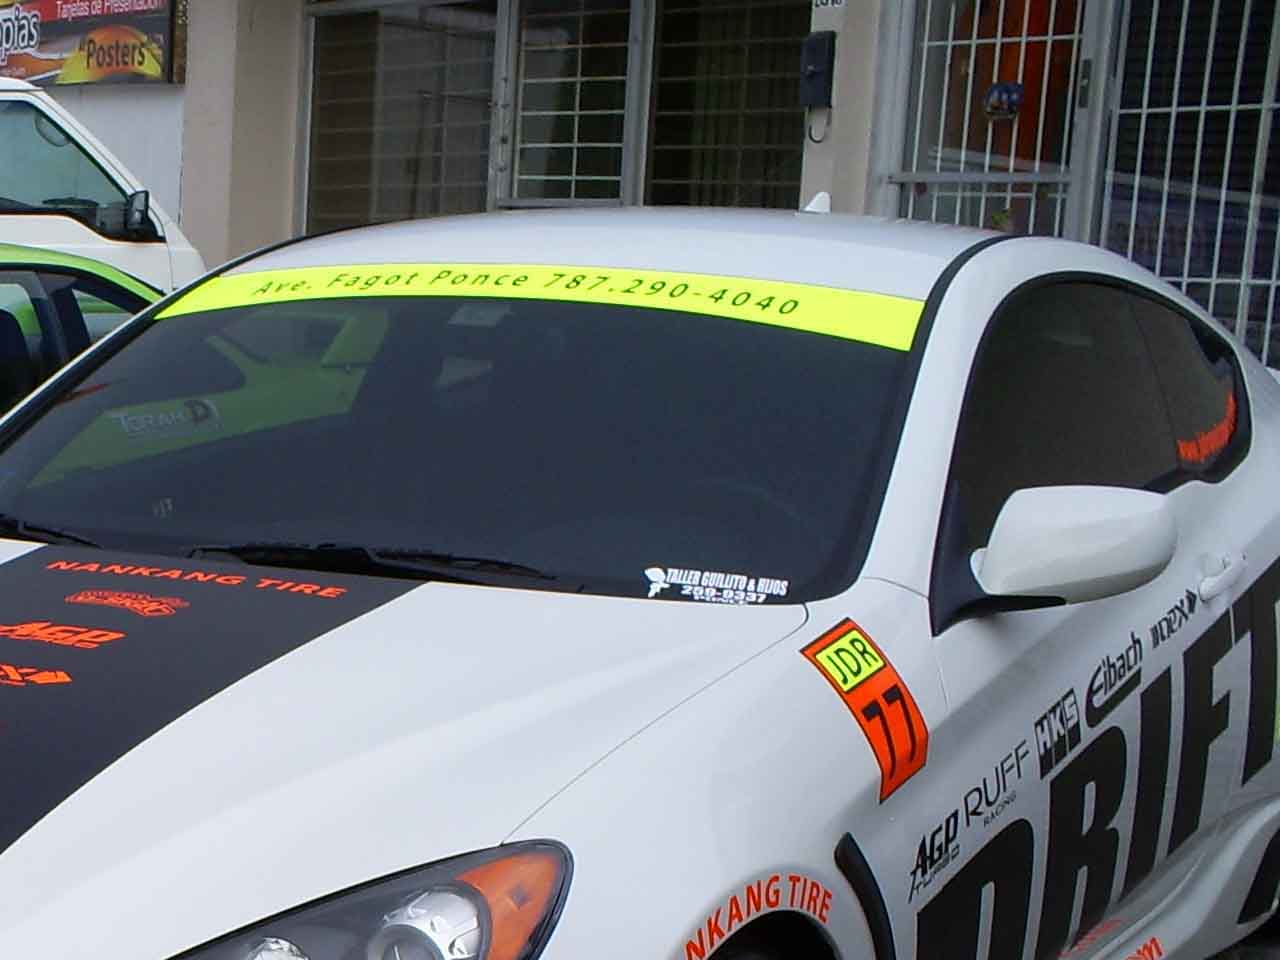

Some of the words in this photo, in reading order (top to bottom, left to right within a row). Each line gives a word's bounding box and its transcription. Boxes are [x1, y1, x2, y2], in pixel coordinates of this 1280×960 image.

[327, 271, 419, 290] Fagot
[428, 269, 529, 287] Ponce
[543, 273, 800, 315] 787.290-4040
[47, 560, 247, 585] NANKANG
[255, 577, 349, 599] TIRE
[666, 568, 702, 585] TALLER
[827, 637, 879, 685] JDR
[861, 684, 917, 780] 77
[964, 739, 1031, 828] RUFF
[1034, 689, 1081, 768] HKS
[1085, 631, 1143, 728] Eibach
[786, 873, 833, 924] TIRE
